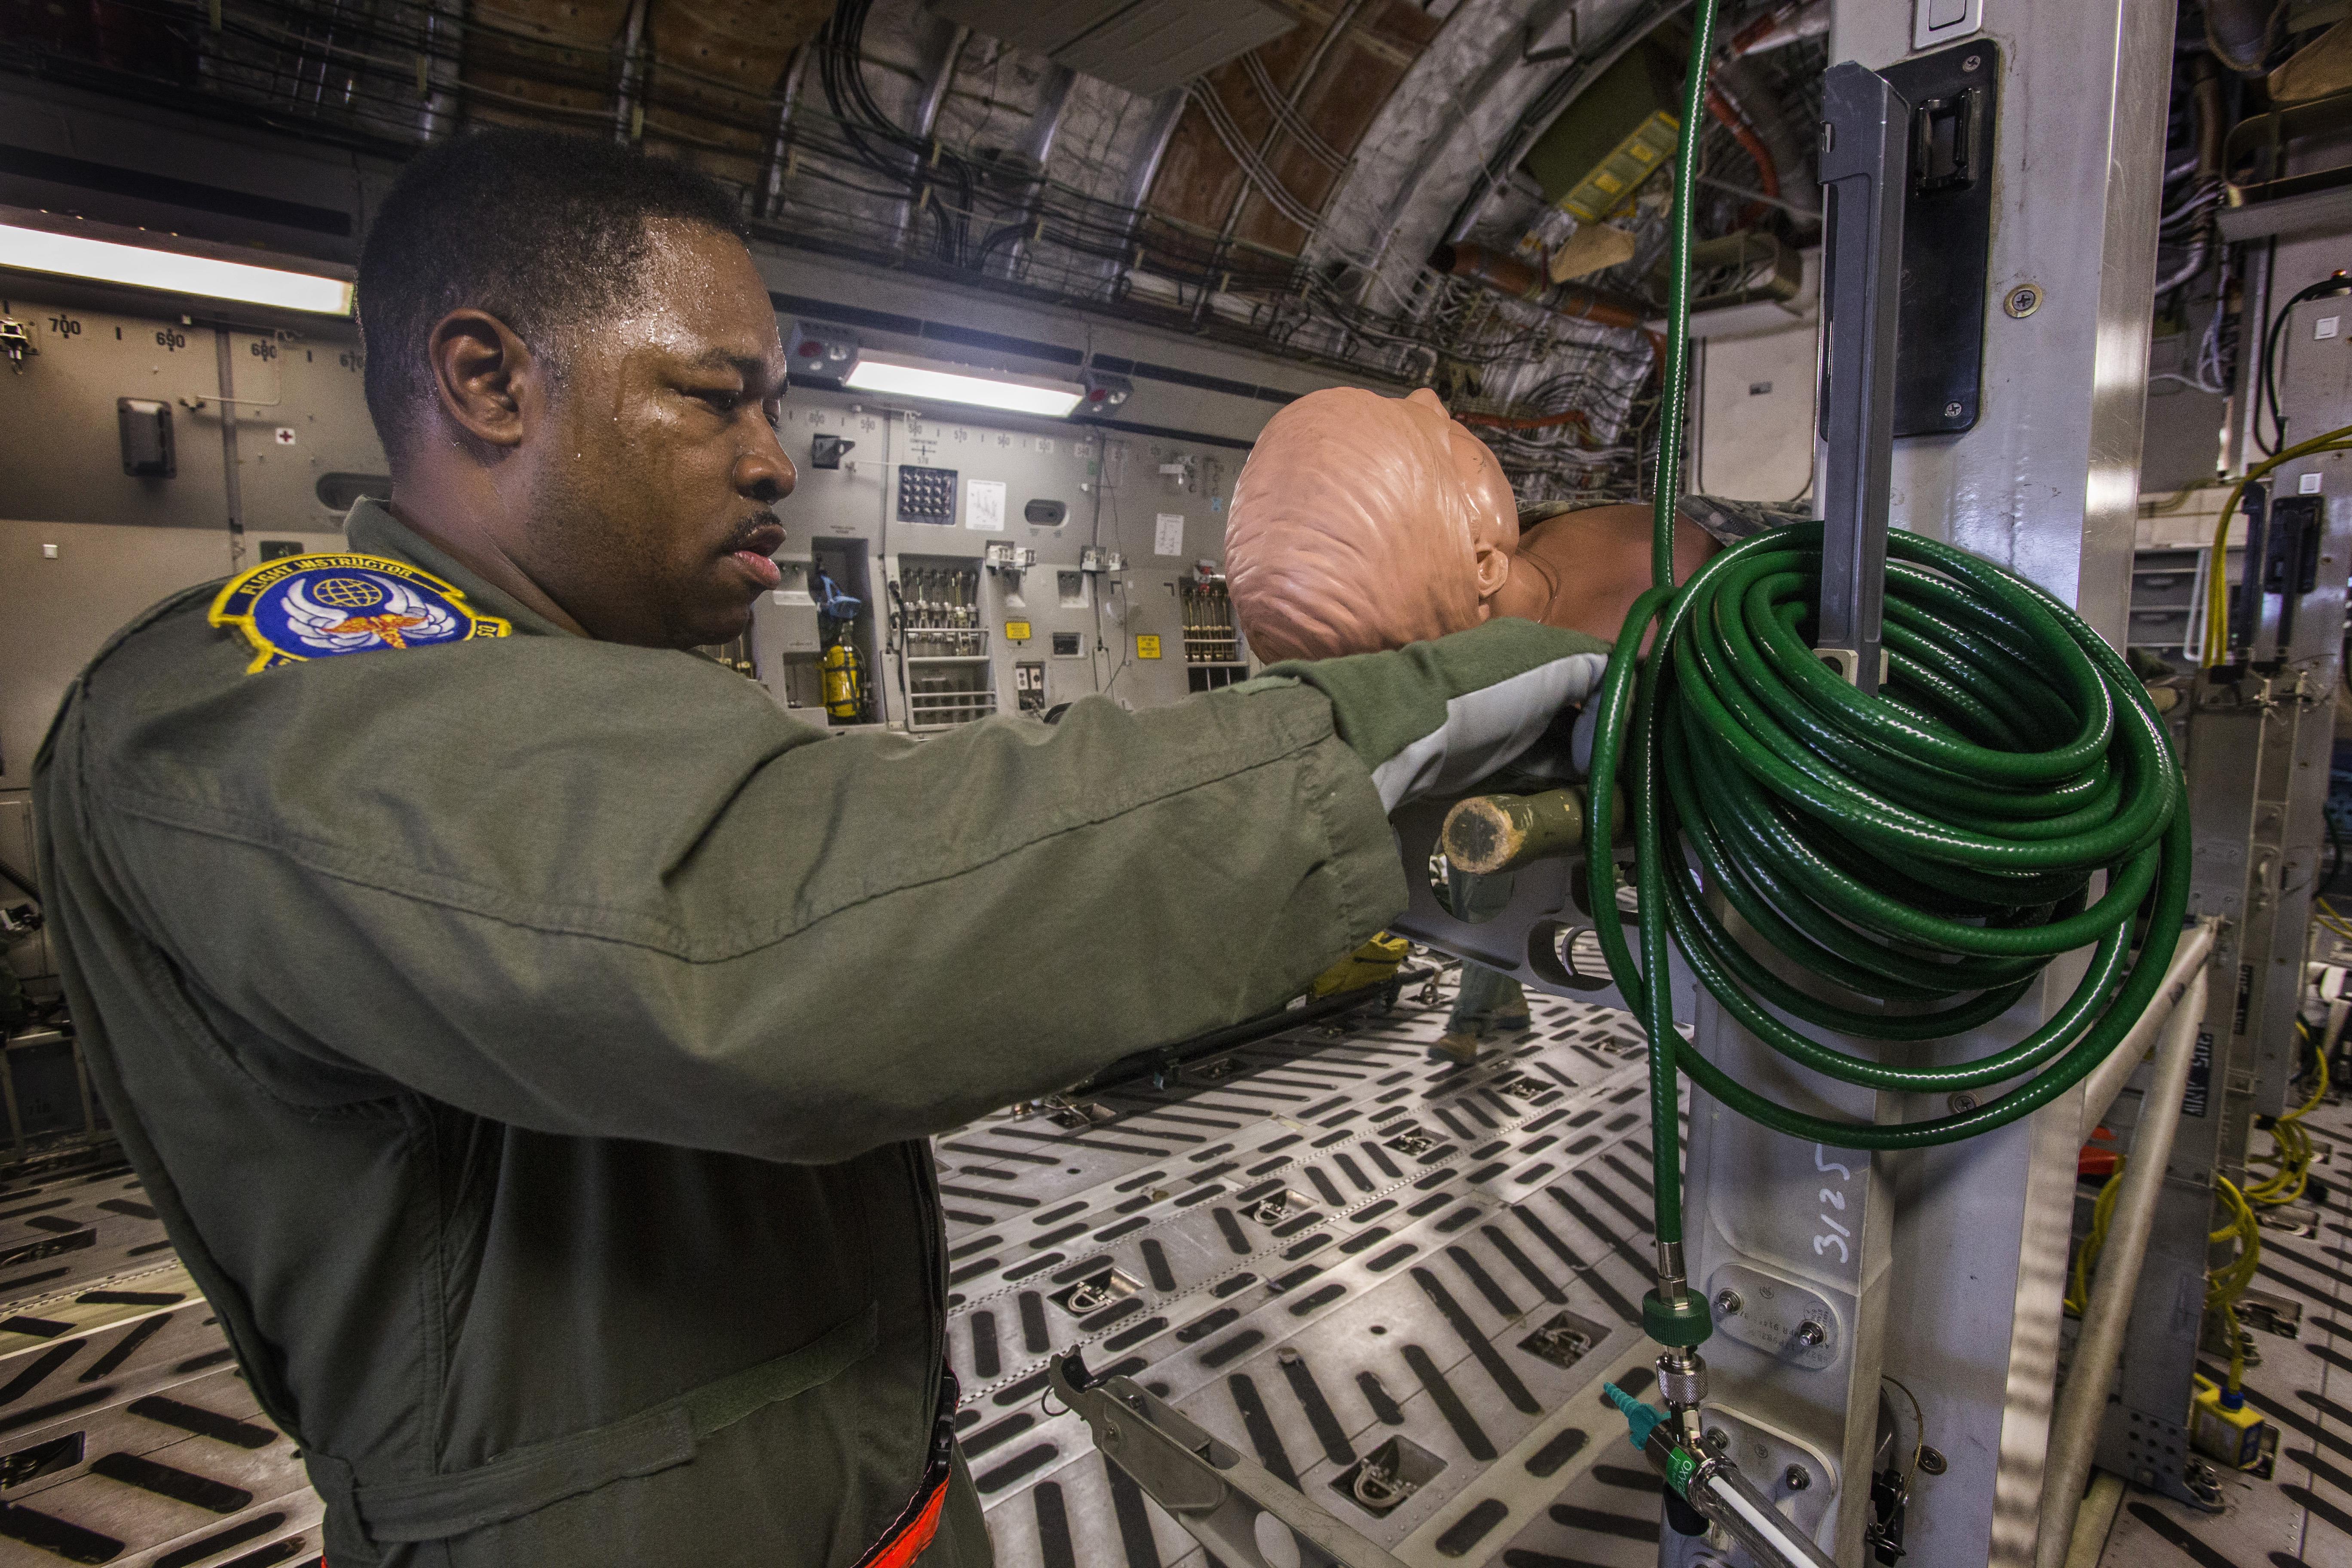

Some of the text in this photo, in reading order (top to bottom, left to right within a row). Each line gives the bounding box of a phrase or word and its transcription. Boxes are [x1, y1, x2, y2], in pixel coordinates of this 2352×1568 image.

[49, 318, 81, 335] 700
[156, 332, 185, 348] 690
[251, 343, 276, 358] 680
[239, 557, 413, 595] FLIGHT INSTRUCTOR
